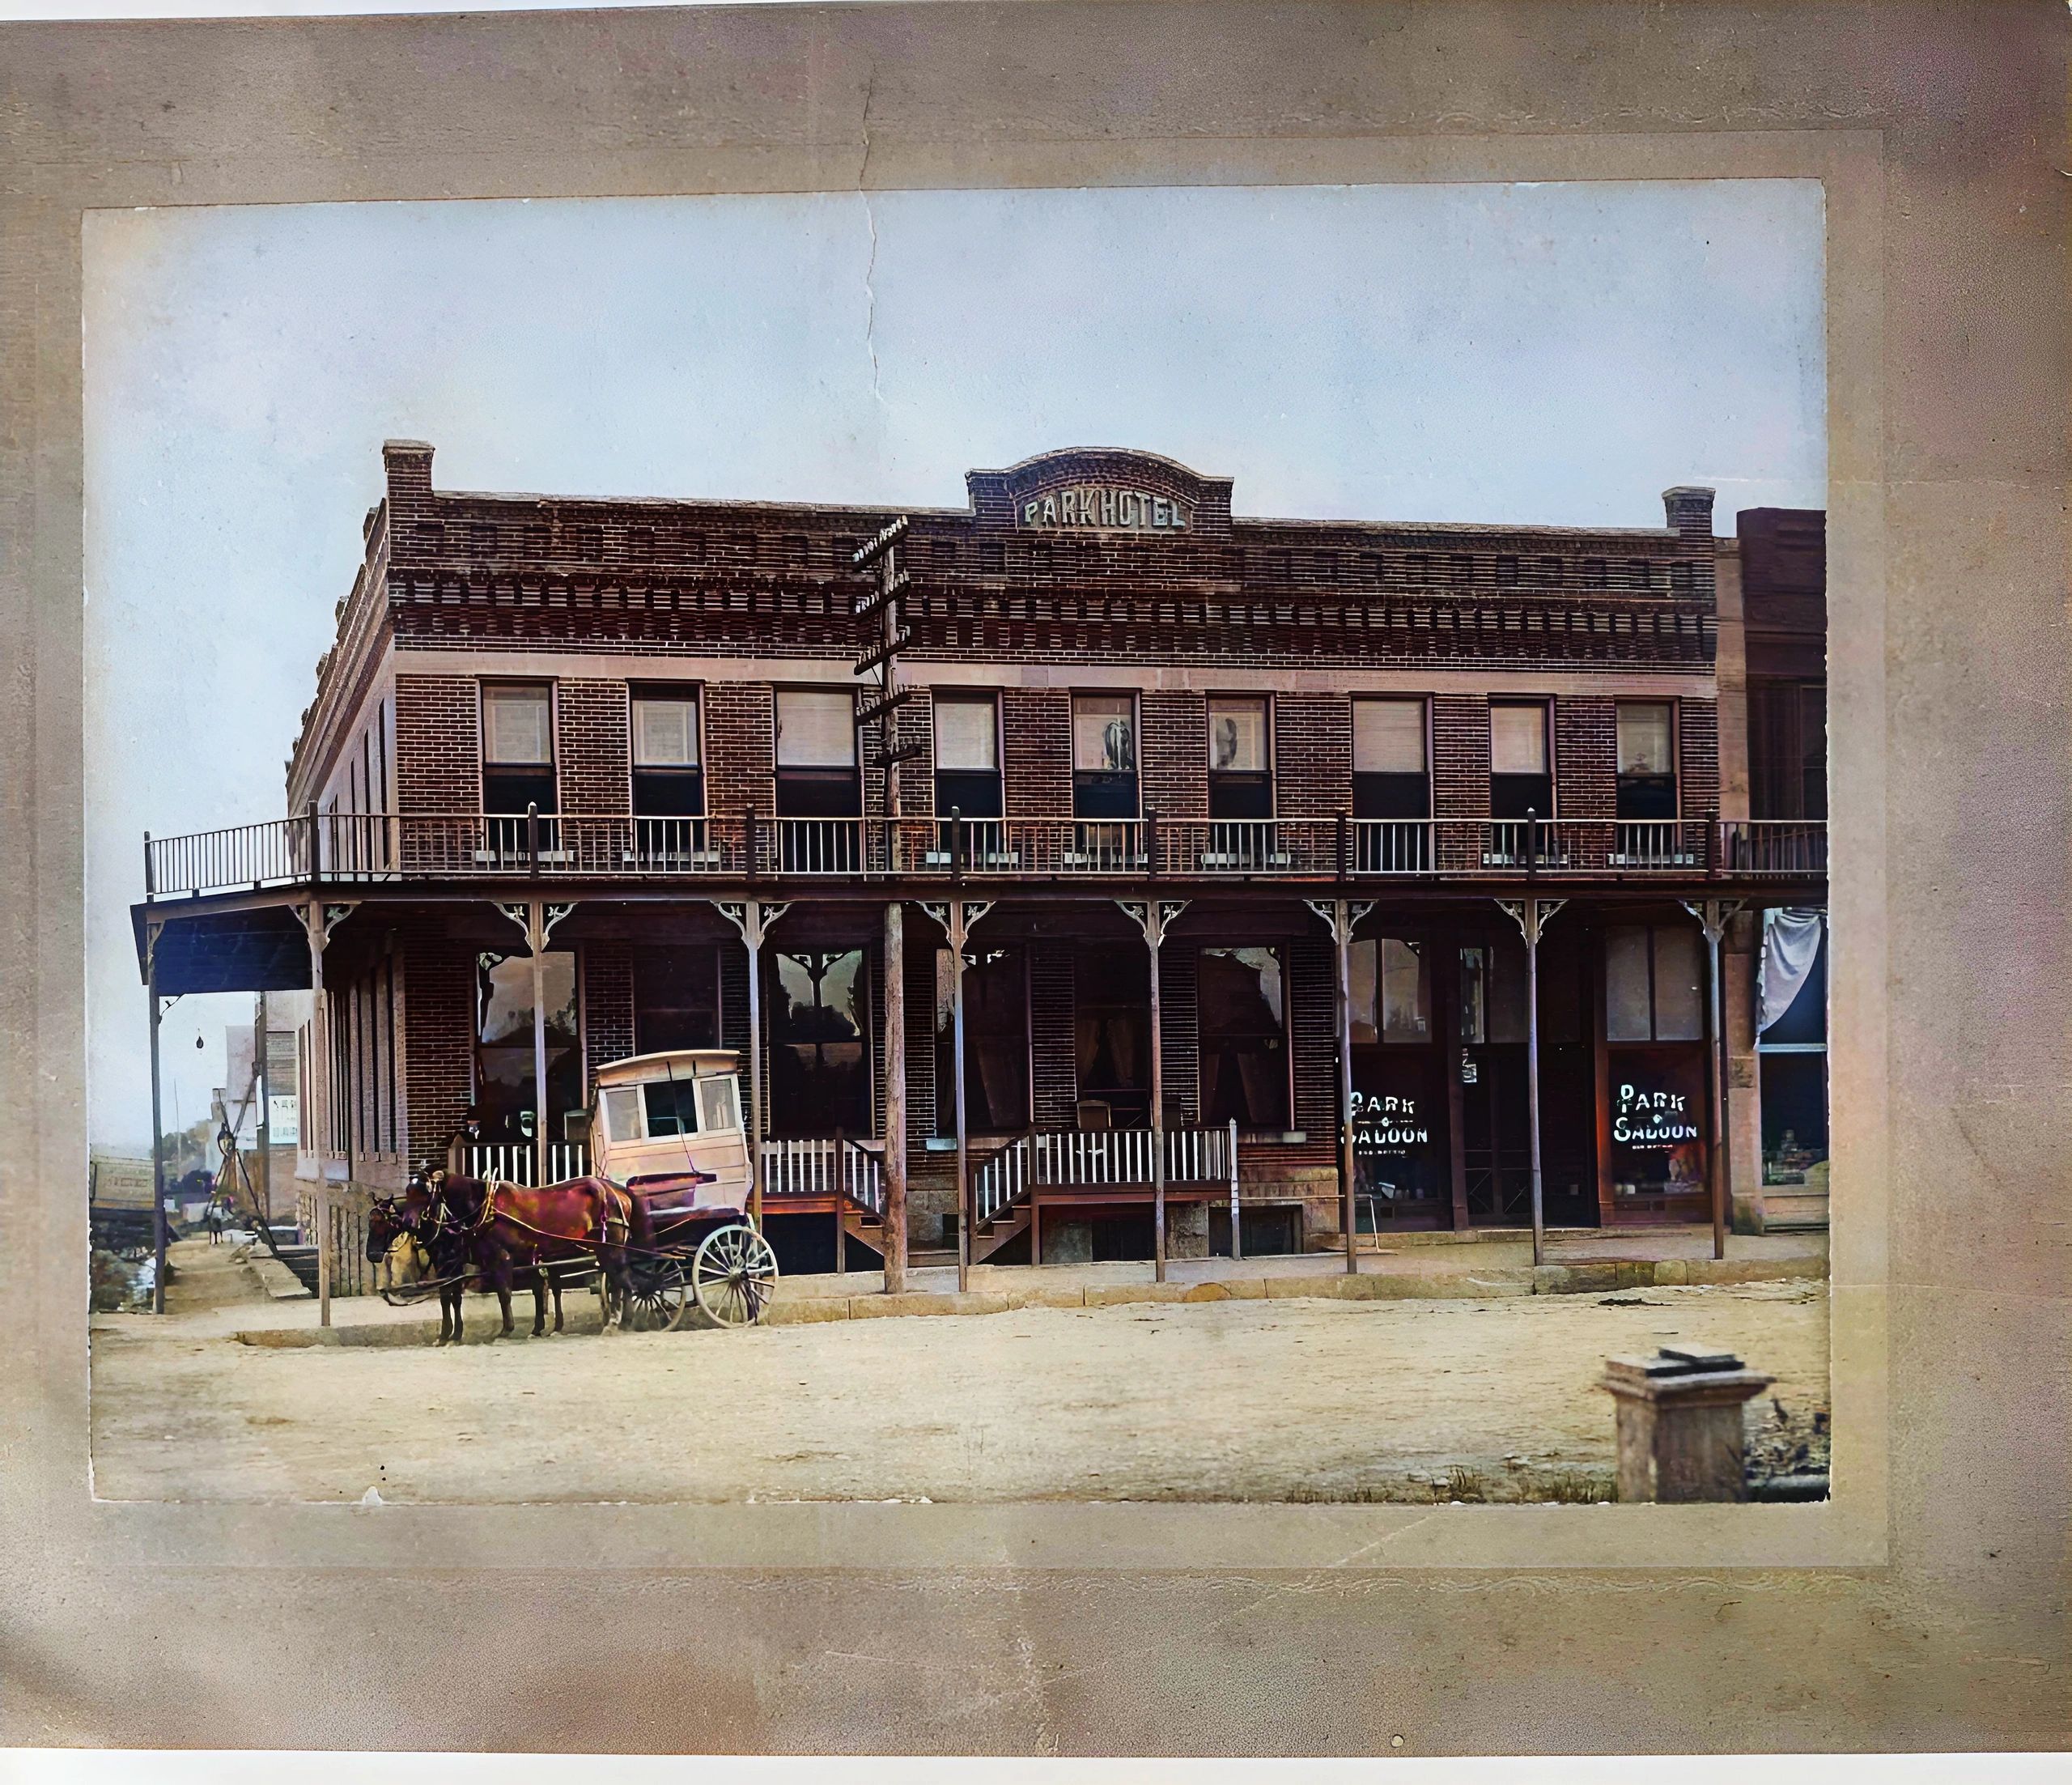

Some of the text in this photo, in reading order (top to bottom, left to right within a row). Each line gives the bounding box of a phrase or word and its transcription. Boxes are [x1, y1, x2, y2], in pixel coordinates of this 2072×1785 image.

[1024, 488, 1186, 526] PARK HOTEL
[1619, 1084, 1686, 1113] PARK
